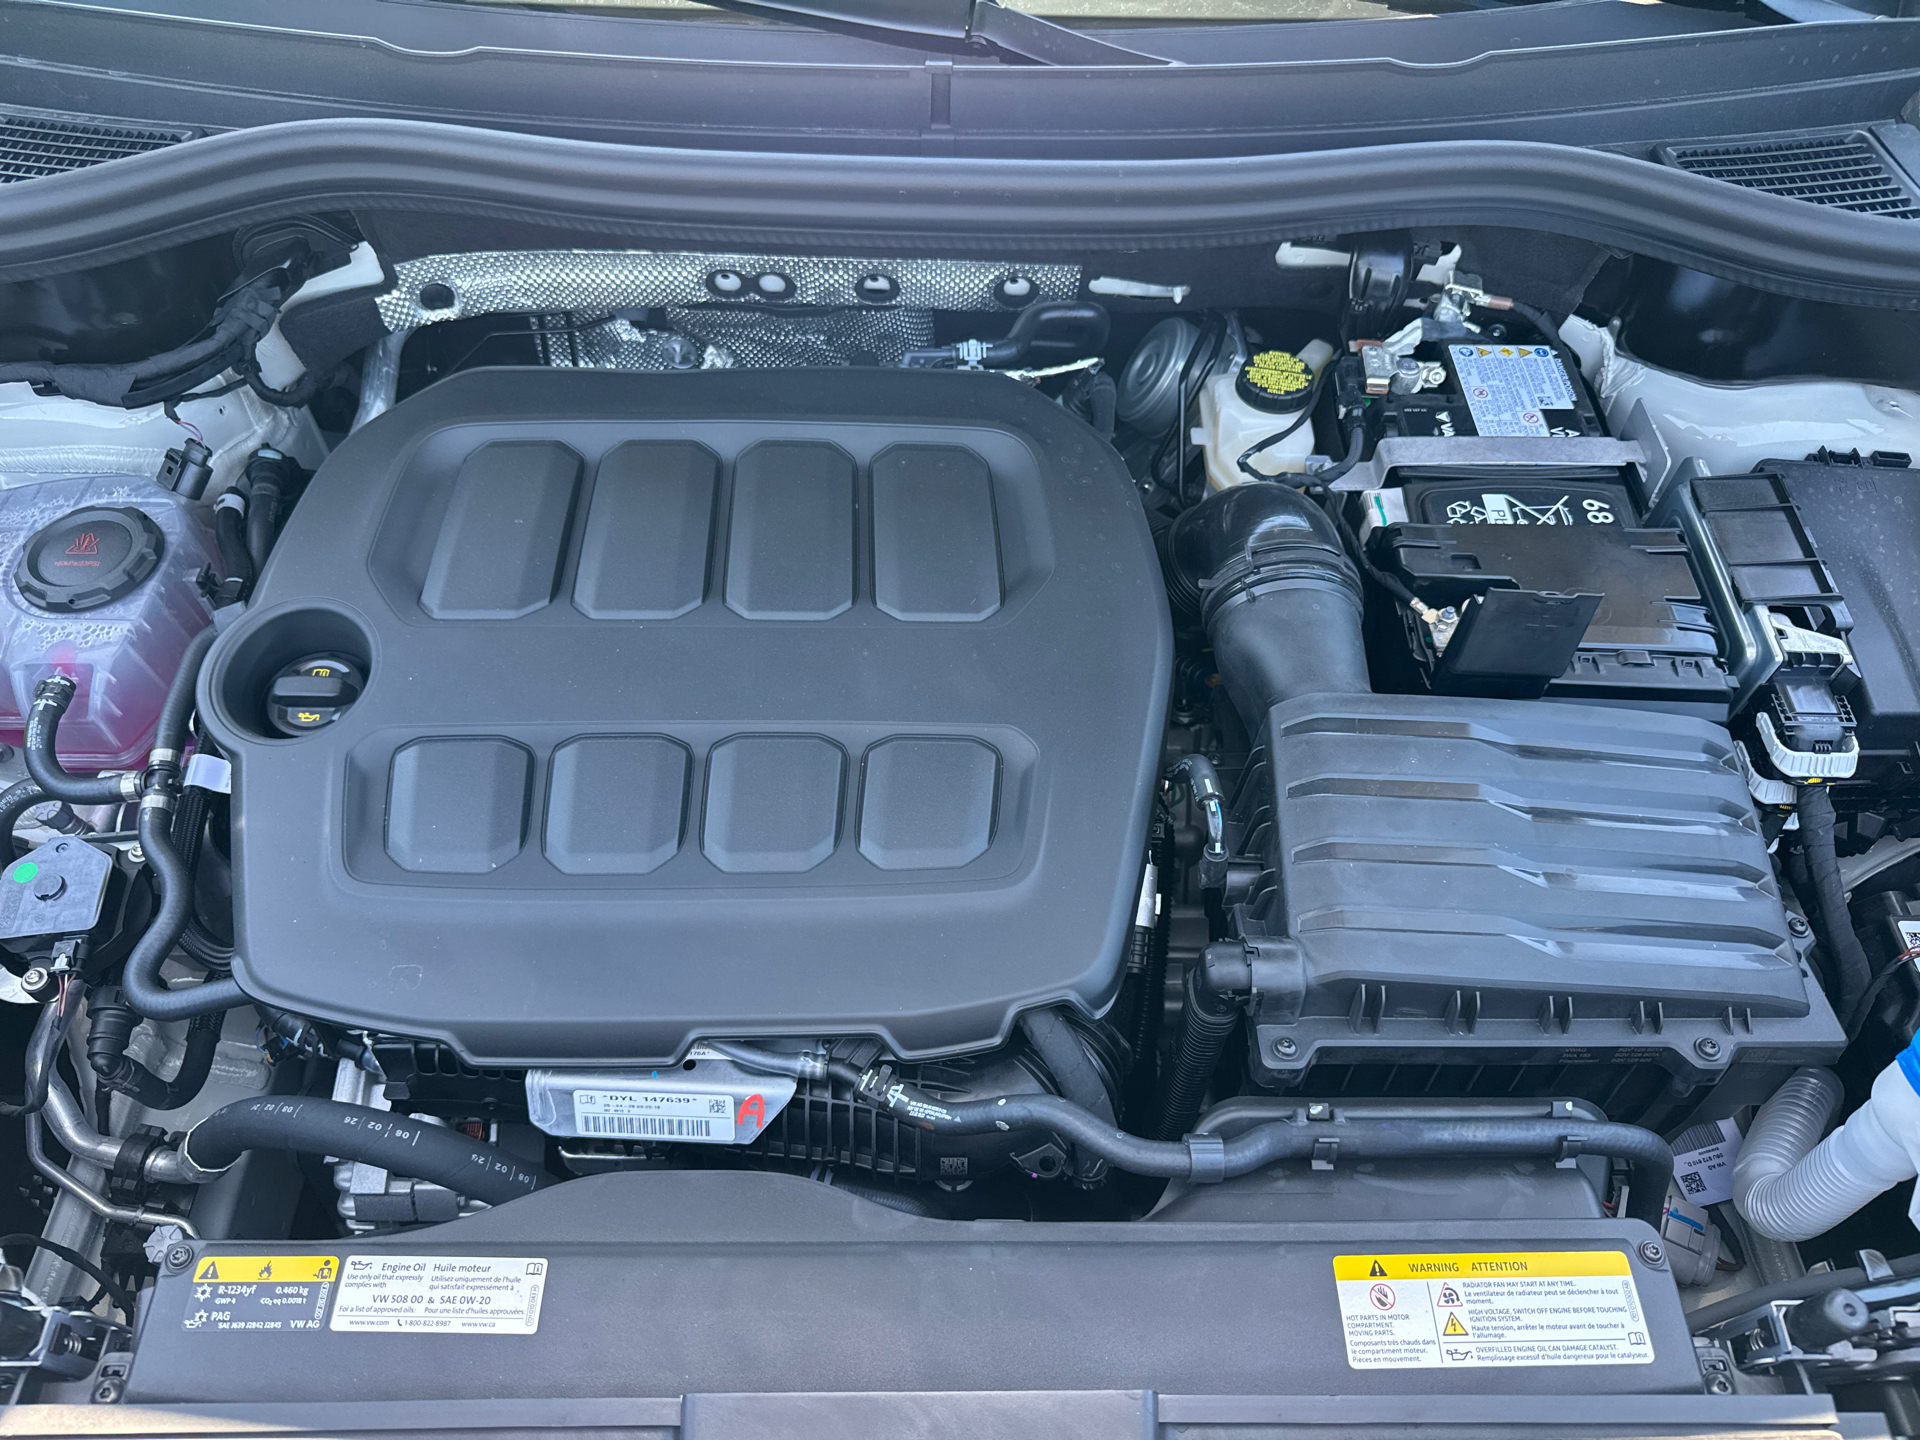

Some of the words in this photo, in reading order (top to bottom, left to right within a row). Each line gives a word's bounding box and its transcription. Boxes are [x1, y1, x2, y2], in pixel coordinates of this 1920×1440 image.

[1582, 498, 1615, 524] 68
[736, 1093, 766, 1128] A
[382, 1263, 411, 1273] Engine
[413, 1263, 426, 1271] Oil
[433, 1264, 456, 1272] Huile
[1408, 1262, 1459, 1272] WARNING
[1471, 1262, 1528, 1272] ATTENTION
[218, 1285, 257, 1297] R-1234yf
[276, 1286, 298, 1294] 0.460
[299, 1286, 309, 1296] kg
[373, 1295, 390, 1303] VW
[391, 1295, 408, 1304] 508
[410, 1295, 424, 1304] 00
[440, 1296, 458, 1304] SAE
[460, 1296, 491, 1305] 0W-20
[211, 1312, 231, 1321] PAG
[290, 1320, 306, 1328] VW
[306, 1320, 320, 1328] AG
[1563, 1353, 1594, 1361] dangereux
